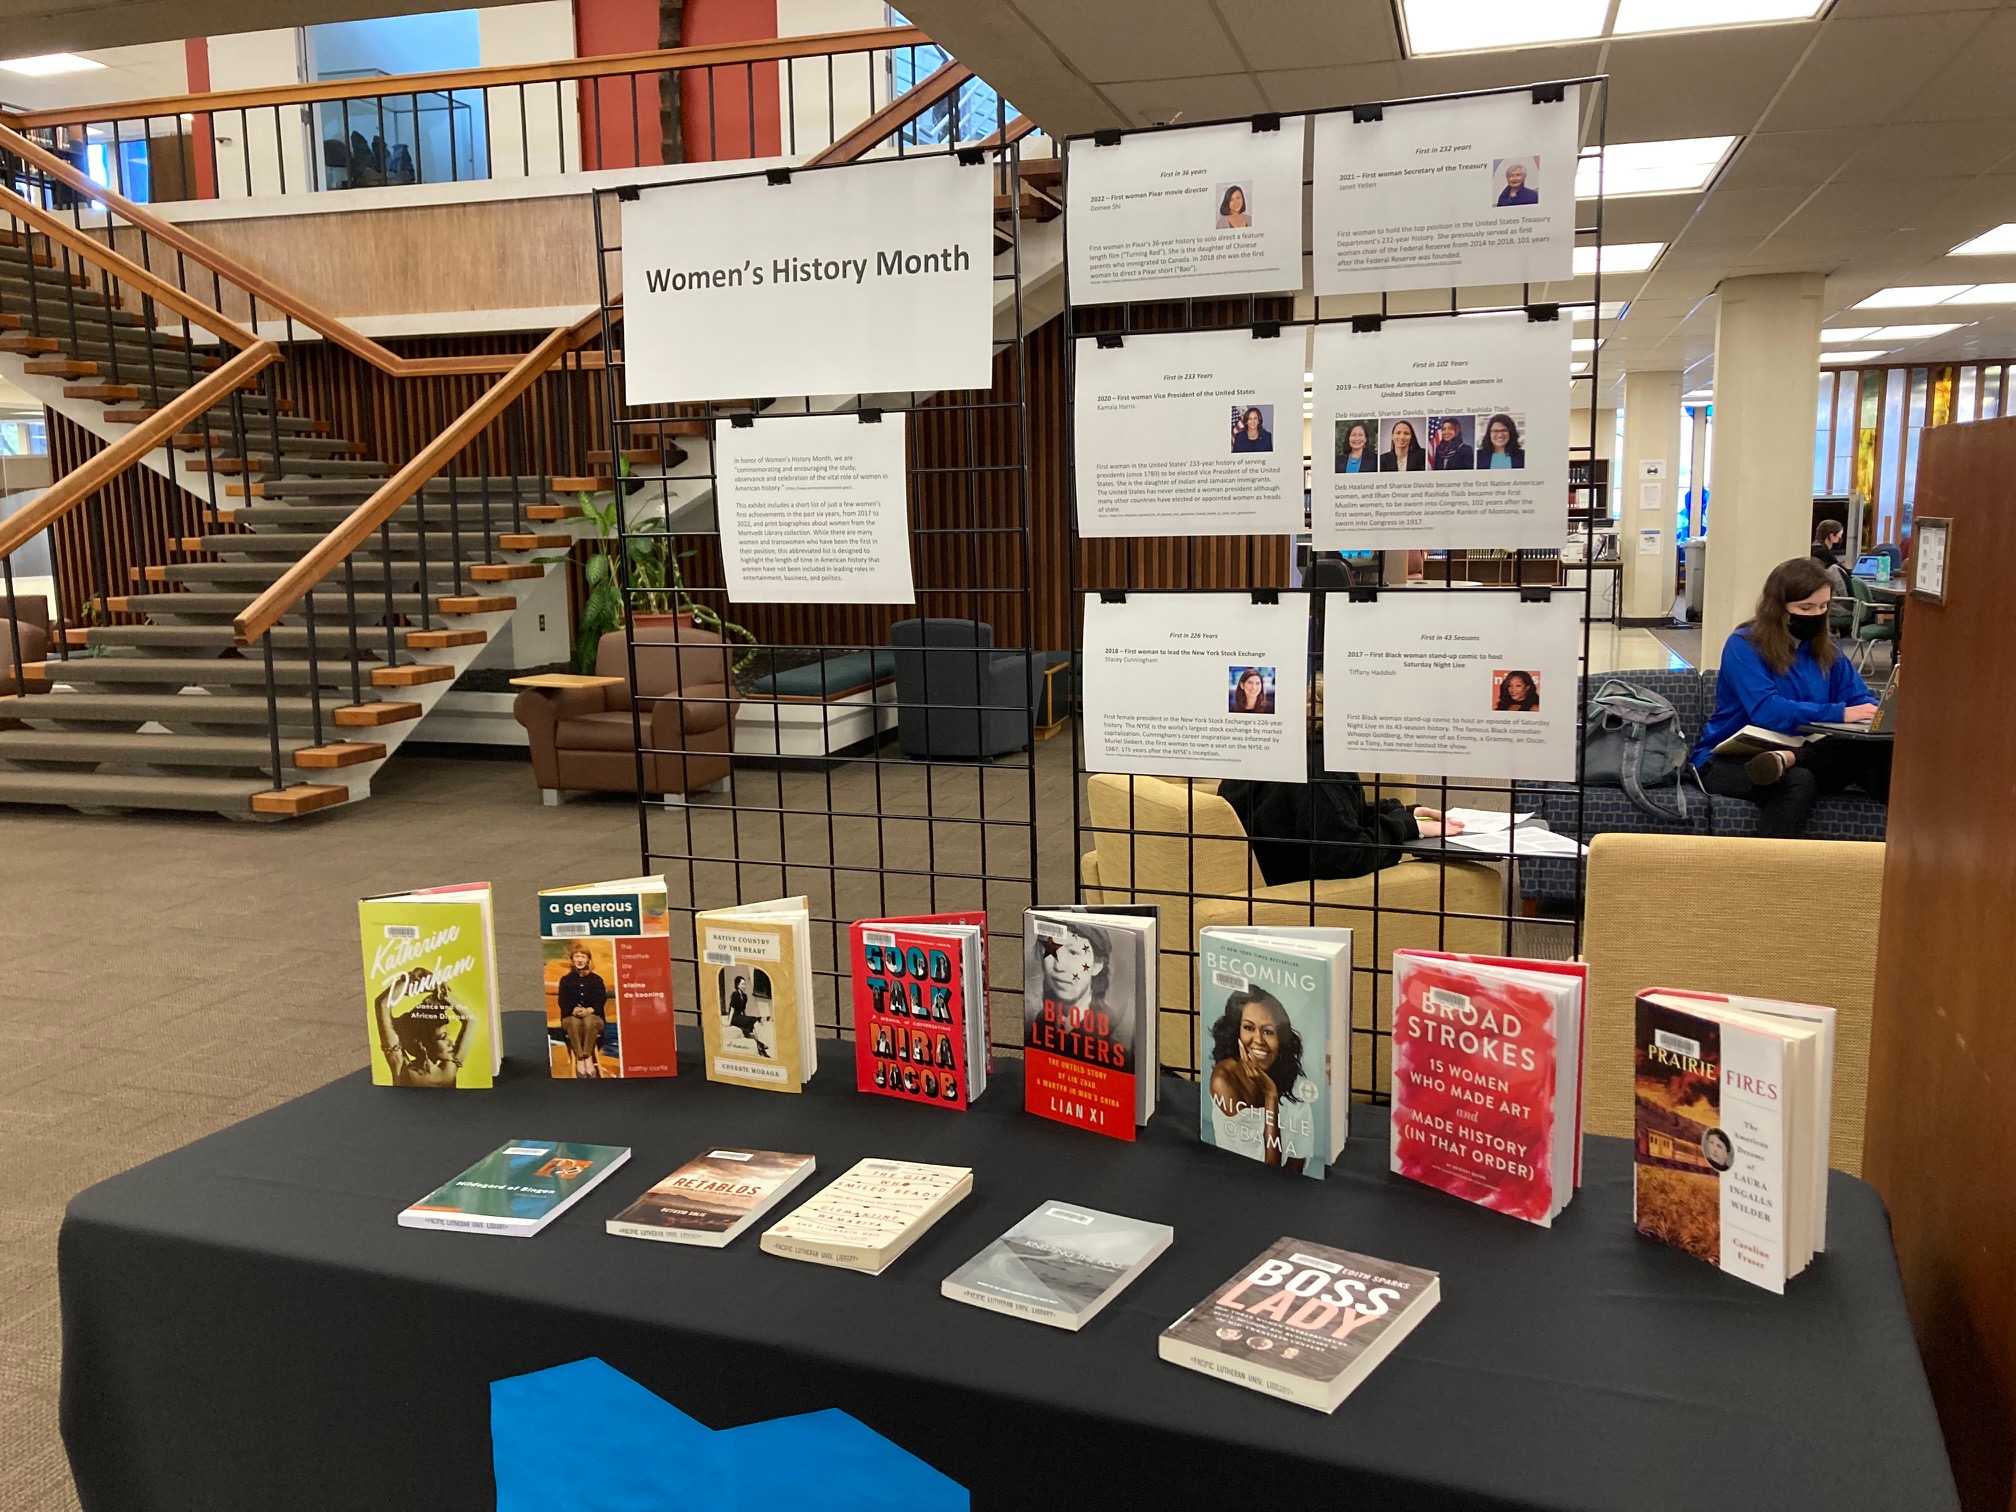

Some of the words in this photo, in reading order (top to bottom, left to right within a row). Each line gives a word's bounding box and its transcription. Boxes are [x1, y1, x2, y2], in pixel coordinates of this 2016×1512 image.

[1453, 144, 1471, 152] years
[1339, 173, 1355, 181] 2021
[1403, 167, 1435, 175] Secretary
[773, 257, 867, 284] History
[877, 244, 970, 276] Month
[1237, 650, 1265, 658] Exchange
[1428, 652, 1457, 660] stand-up
[1433, 661, 1451, 669] Night
[550, 903, 560, 913] a
[565, 902, 632, 916] generous
[591, 917, 633, 928] vision
[371, 925, 460, 979] Katherine
[738, 936, 770, 945] COUNTRY
[743, 946, 766, 955] HEART
[865, 945, 952, 985] GOOD
[1207, 952, 1316, 991] BECOMING
[381, 955, 475, 1008] Dunham
[635, 991, 664, 999] kooning
[867, 977, 954, 1024] TALK
[1044, 999, 1110, 1037] BLOOD
[868, 1021, 956, 1070] MIRA
[1032, 1022, 1125, 1067] LETTERS
[1408, 1016, 1535, 1071] STROKES
[752, 1067, 780, 1077] MORAGA
[1049, 1058, 1059, 1067] THE
[1061, 1061, 1085, 1075] UNTOLD
[1087, 1068, 1107, 1080] STORY
[1058, 1072, 1066, 1080] OF
[1068, 1074, 1078, 1083] LIN
[1430, 1058, 1444, 1073] 15
[1449, 1064, 1509, 1094] WOMEN
[1648, 1045, 1716, 1081] PRAIRIE
[1726, 1070, 1778, 1100] FIRES
[872, 1061, 958, 1101] JACOB
[1043, 1080, 1068, 1093] MARTYR
[1101, 1095, 1120, 1108] CHINA
[1410, 1071, 1445, 1092] WHO
[1451, 1085, 1494, 1110] MADE
[1499, 1098, 1531, 1119] ART
[1051, 1097, 1084, 1119] LIAN
[1090, 1108, 1104, 1125] XI
[1211, 1093, 1311, 1137] MICHELLE
[1456, 1108, 1479, 1123] and
[1412, 1110, 1454, 1133] MADE
[1459, 1124, 1528, 1158] HISTORY
[1744, 1121, 1758, 1132] The
[1224, 1121, 1298, 1157] OBAMA
[1734, 1131, 1769, 1149] American
[1404, 1124, 1426, 1143] (IN
[1430, 1134, 1468, 1157] THAT
[1472, 1149, 1535, 1181] ORDER)
[673, 1178, 761, 1195] RETABLOS
[836, 1181, 887, 1193] SMILED
[900, 1188, 940, 1198] BEADS
[1734, 1173, 1768, 1191] LAURA
[1729, 1185, 1773, 1208] INGALLS
[1731, 1200, 1771, 1222] WILDER
[1024, 1240, 1075, 1259] KNITTING
[1077, 1254, 1095, 1264] THE
[1097, 1258, 1123, 1269] FOG
[1733, 1237, 1770, 1260] Caroline
[1738, 1252, 1766, 1269] Fraser
[1248, 1258, 1401, 1316] BOSS
[1341, 1268, 1370, 1281] EDITH
[1372, 1274, 1411, 1290] SPARKS
[1216, 1278, 1382, 1340] LADY
[1217, 1364, 1246, 1381] LUTHERAN
